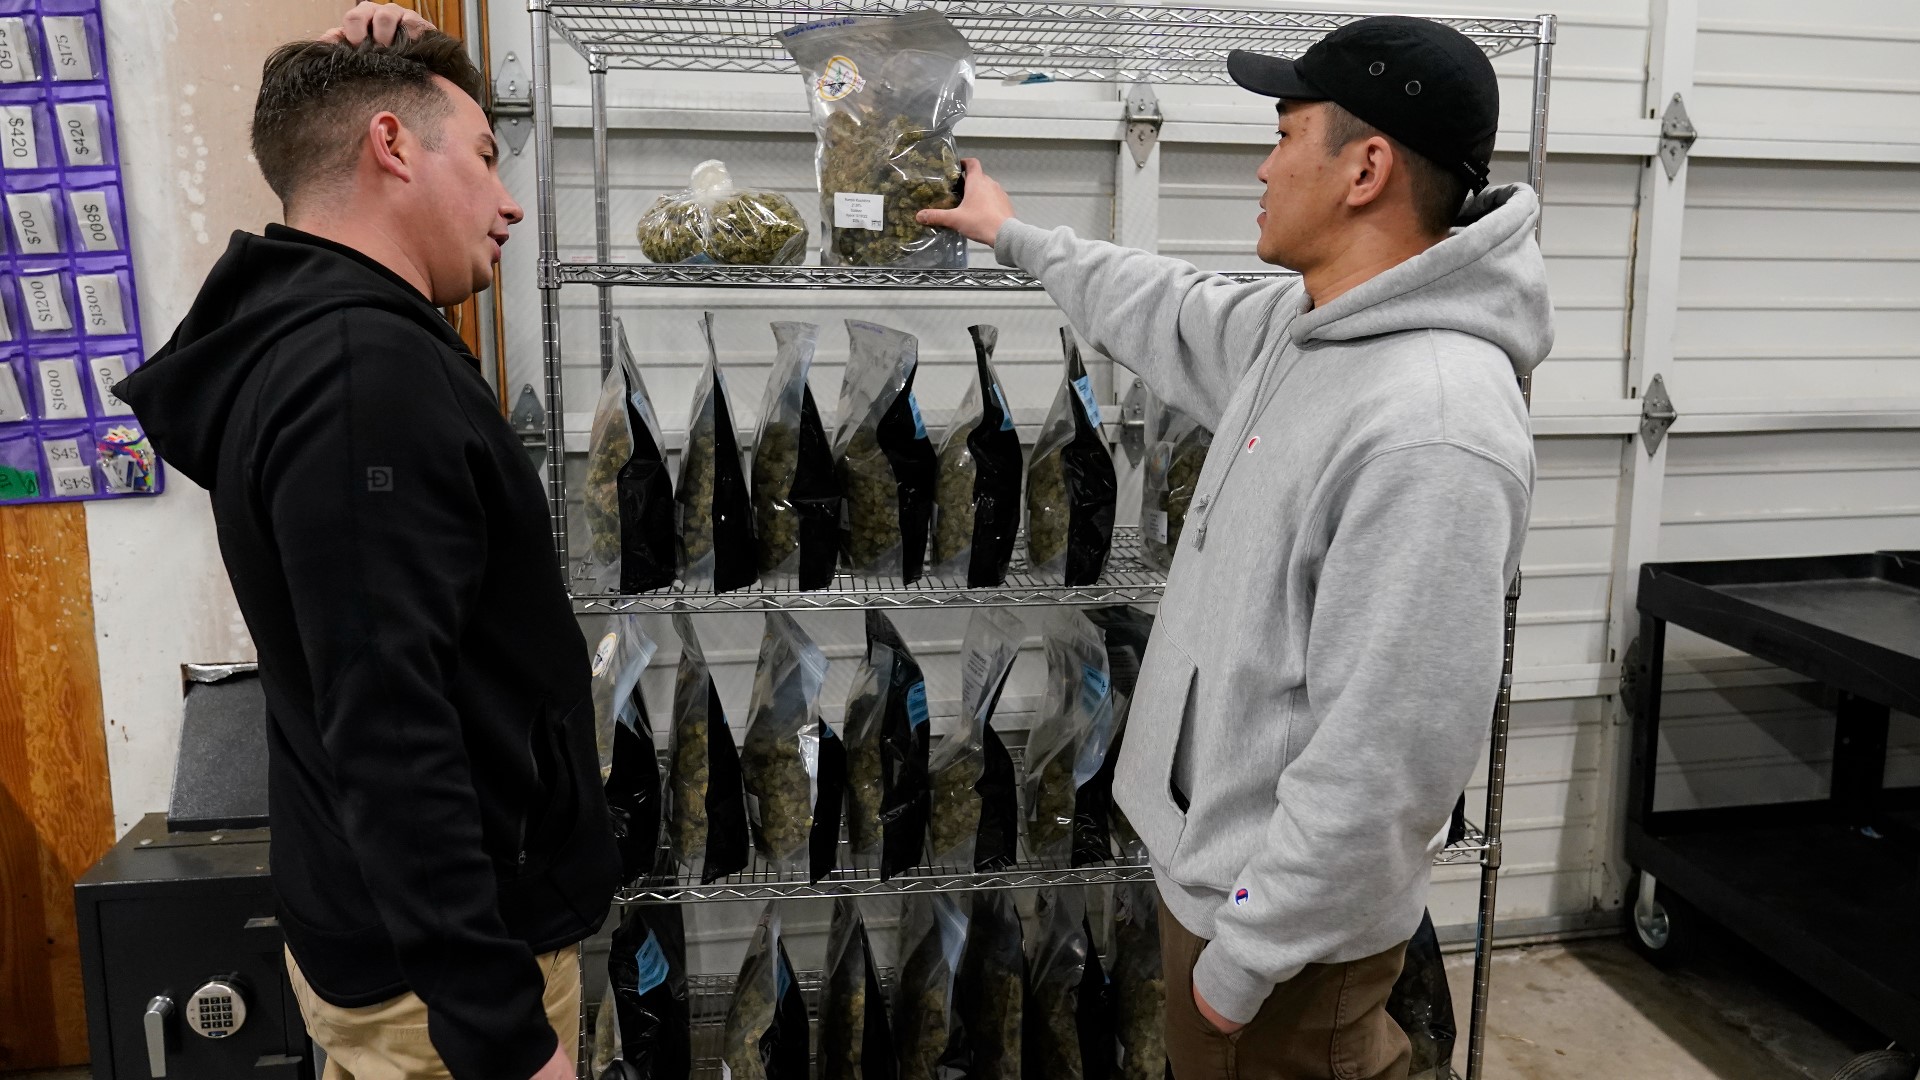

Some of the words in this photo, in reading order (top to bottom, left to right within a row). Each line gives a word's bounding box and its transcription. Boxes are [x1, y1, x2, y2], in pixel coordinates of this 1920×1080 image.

[55, 34, 77, 66] $175
[8, 117, 28, 158] $420
[67, 119, 89, 156] $420
[18, 210, 42, 245] $700
[83, 204, 107, 242] $800
[30, 281, 53, 323] $1200
[84, 285, 106, 326] $1300
[47, 369, 67, 411] $1600
[51, 447, 79, 462] $45
